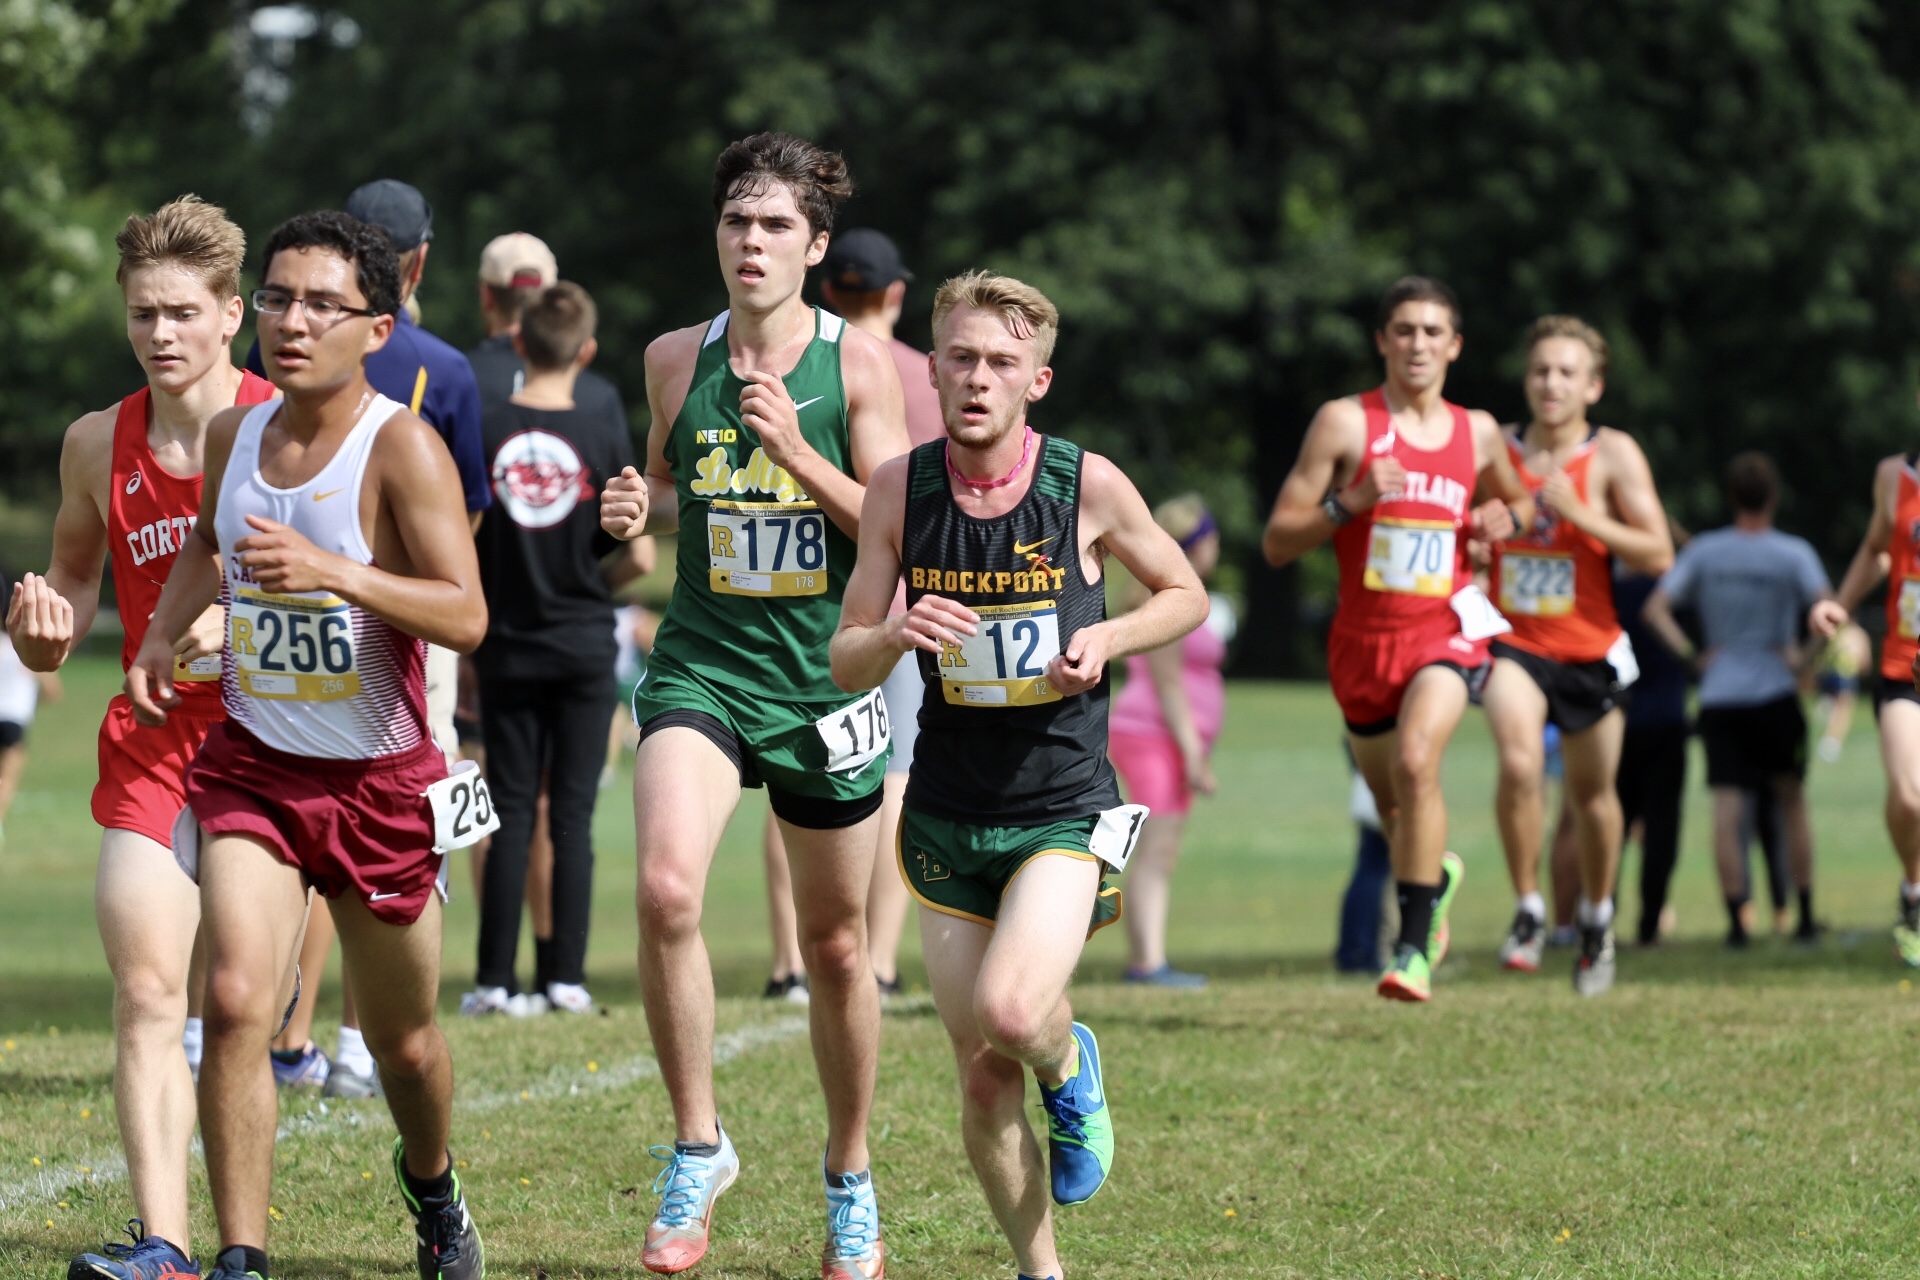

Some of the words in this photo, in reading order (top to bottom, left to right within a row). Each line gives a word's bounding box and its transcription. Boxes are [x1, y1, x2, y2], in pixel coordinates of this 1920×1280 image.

[696, 429, 737, 444] NE10
[690, 446, 732, 497] Le
[729, 503, 760, 511] University
[766, 509, 801, 517] Invitational
[127, 516, 198, 566] CORT
[710, 525, 736, 558] R
[742, 517, 824, 571] 178
[1407, 532, 1442, 573] 70
[796, 576, 814, 588] 178
[912, 567, 1066, 593] BROCKPORT
[1518, 558, 1572, 595] 222
[995, 611, 1032, 620] Invitational
[232, 616, 257, 655] R
[257, 610, 352, 674] 256
[986, 620, 1043, 679] 12
[321, 680, 345, 693] 256
[1034, 682, 1047, 695] 12
[840, 691, 887, 756] 178
[450, 774, 494, 838] 25
